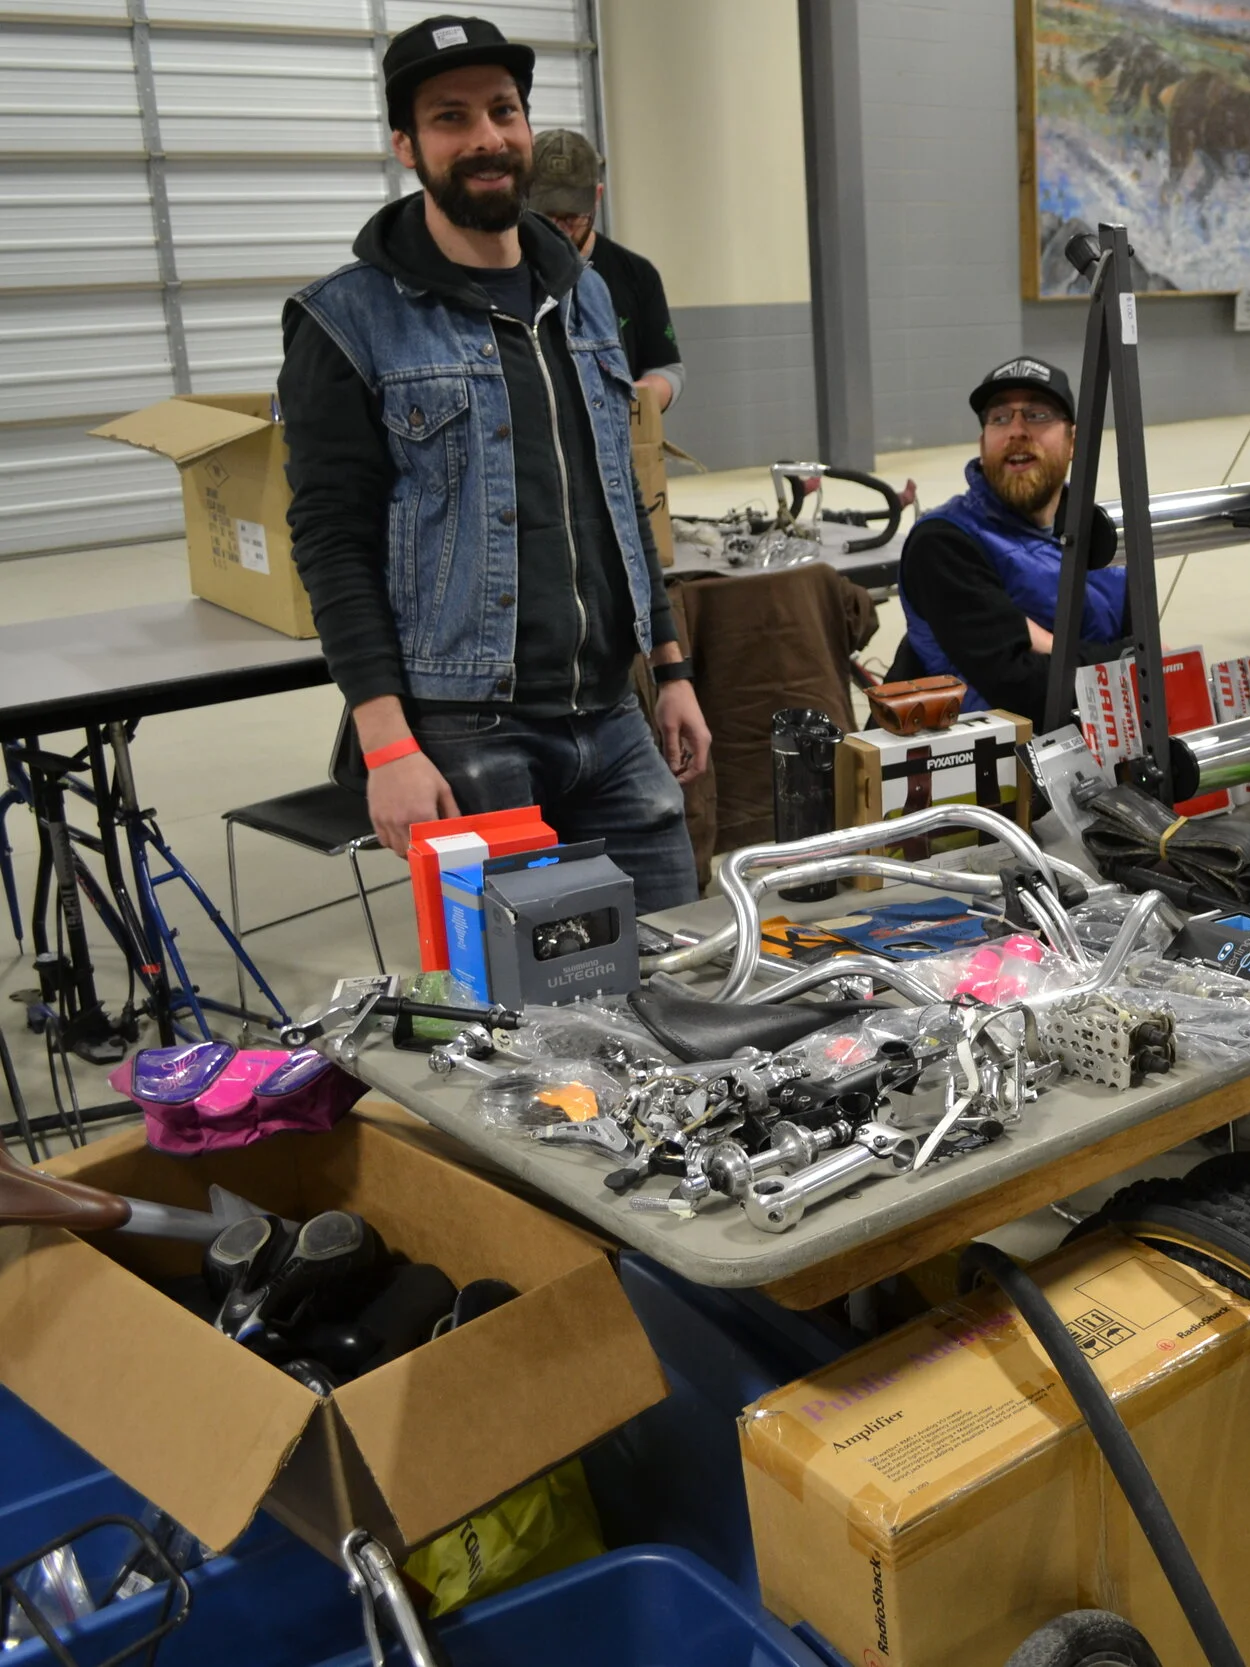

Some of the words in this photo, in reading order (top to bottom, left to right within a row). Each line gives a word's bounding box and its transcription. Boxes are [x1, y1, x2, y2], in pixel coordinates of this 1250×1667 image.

[926, 751, 975, 771] FYXATION
[547, 962, 616, 989] ULTEGRA
[562, 959, 600, 974] SHIMANO
[1176, 1306, 1231, 1339] RadioShack
[801, 1370, 901, 1423] Public
[907, 1312, 1016, 1372] Address
[832, 1409, 904, 1454] Amplifier
[869, 1556, 890, 1657] RadioShack
